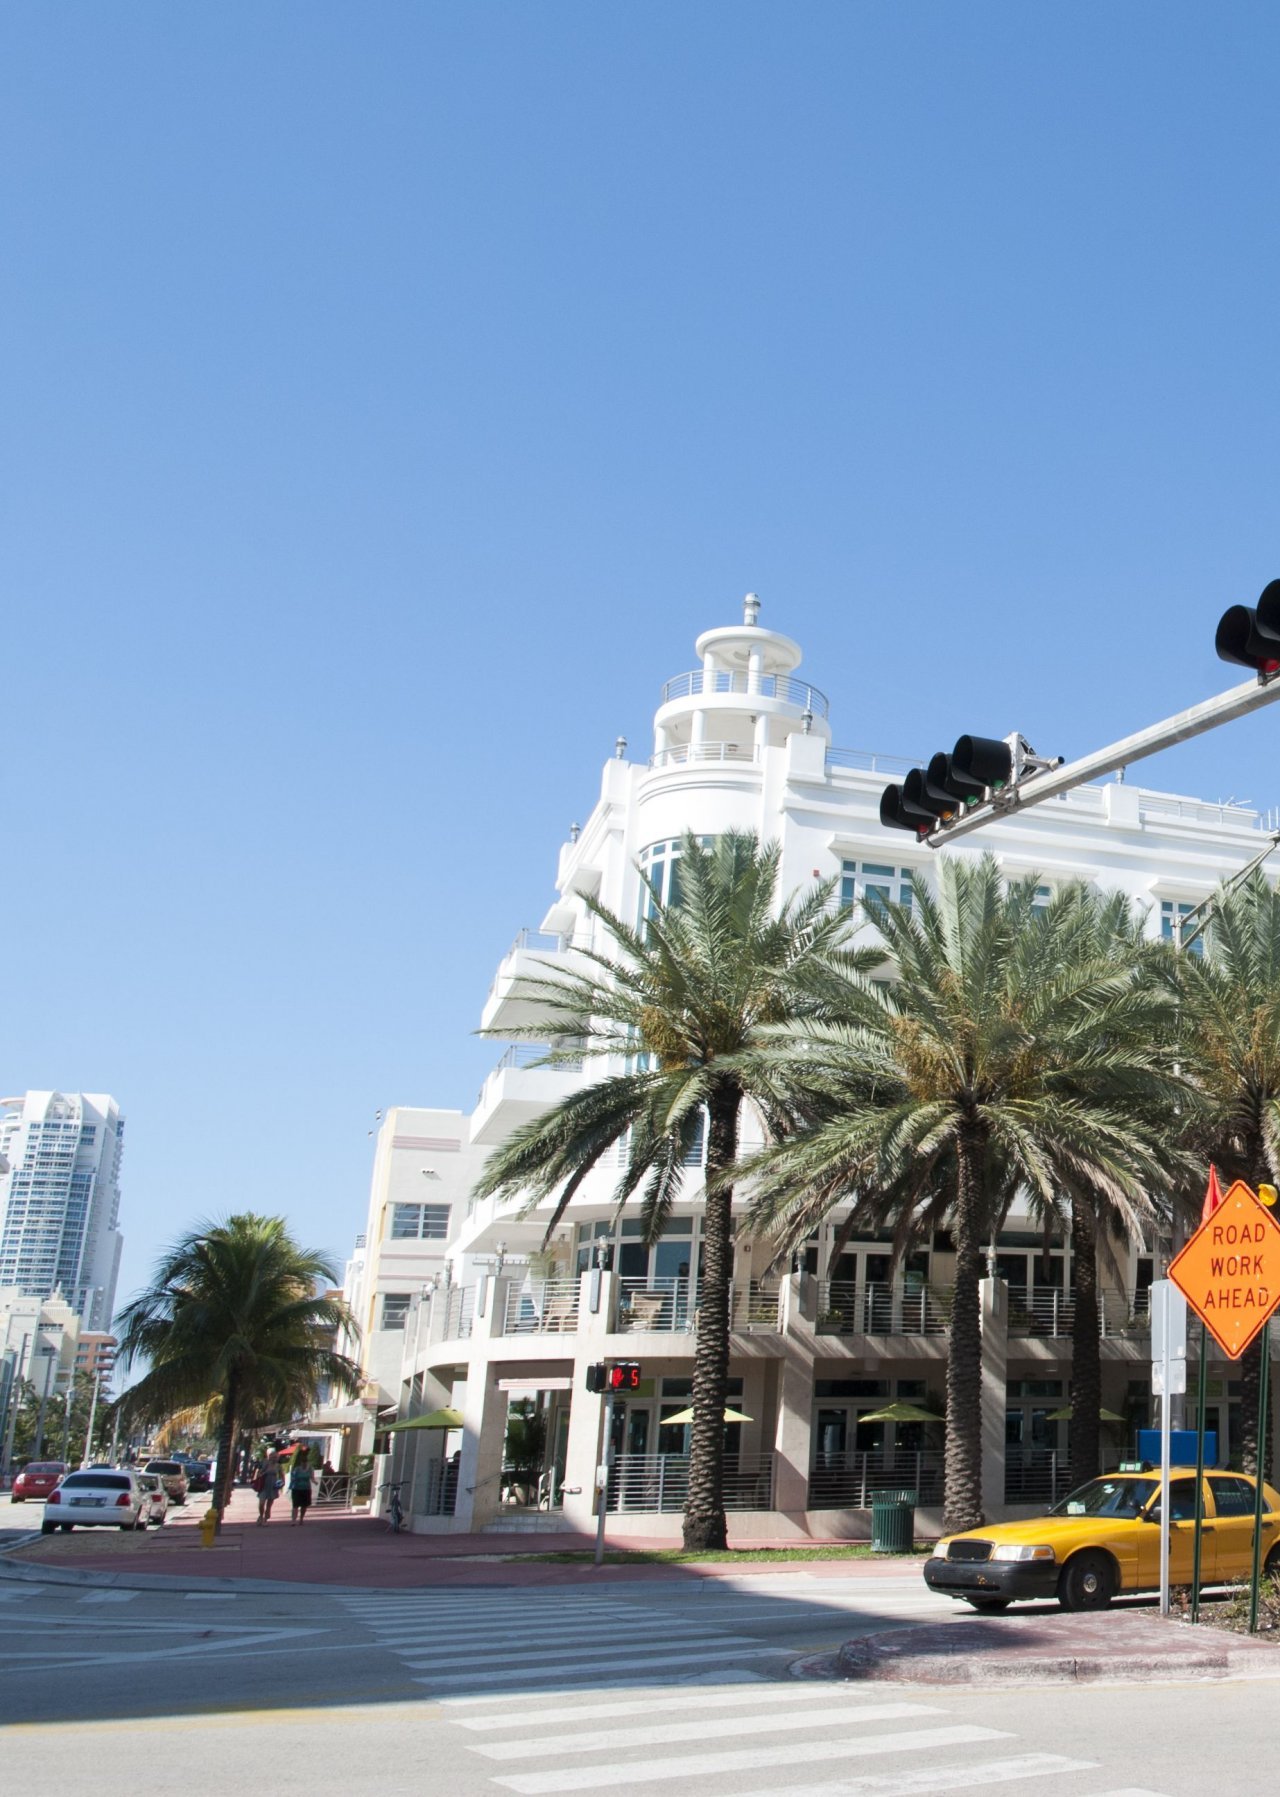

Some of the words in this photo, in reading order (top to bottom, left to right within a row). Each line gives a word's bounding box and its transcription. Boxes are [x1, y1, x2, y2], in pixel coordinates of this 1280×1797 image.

[1212, 1223, 1265, 1245] ROAD
[1211, 1255, 1264, 1277] WORK
[1203, 1287, 1269, 1309] AHEAD
[631, 1368, 638, 1387] 5
